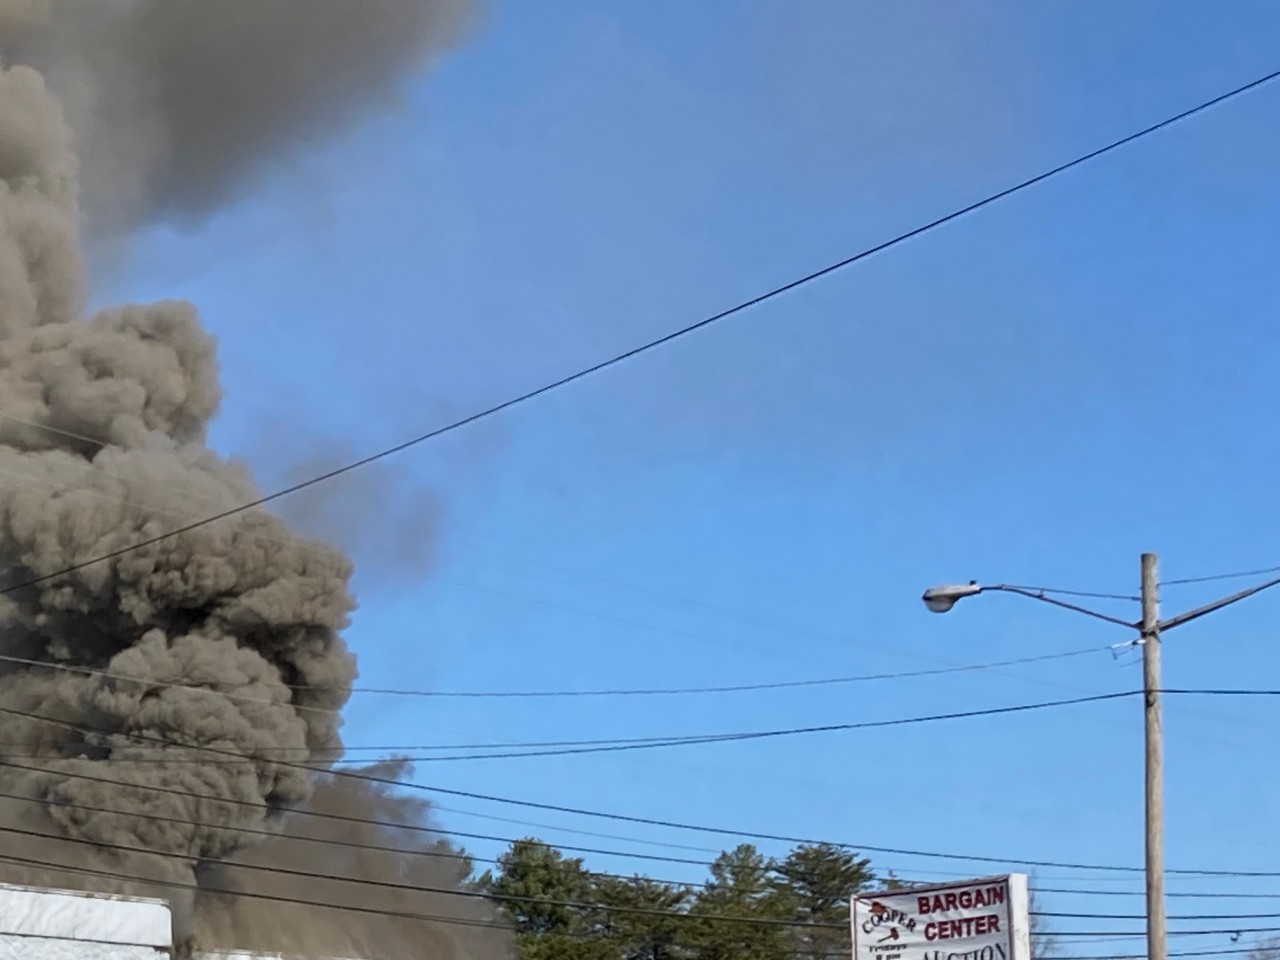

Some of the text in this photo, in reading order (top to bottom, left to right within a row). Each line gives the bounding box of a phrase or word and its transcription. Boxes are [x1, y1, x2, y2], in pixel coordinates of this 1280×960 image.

[917, 886, 1004, 915] BARGAIN
[862, 908, 916, 934] COOPER
[924, 914, 1001, 941] CENTER
